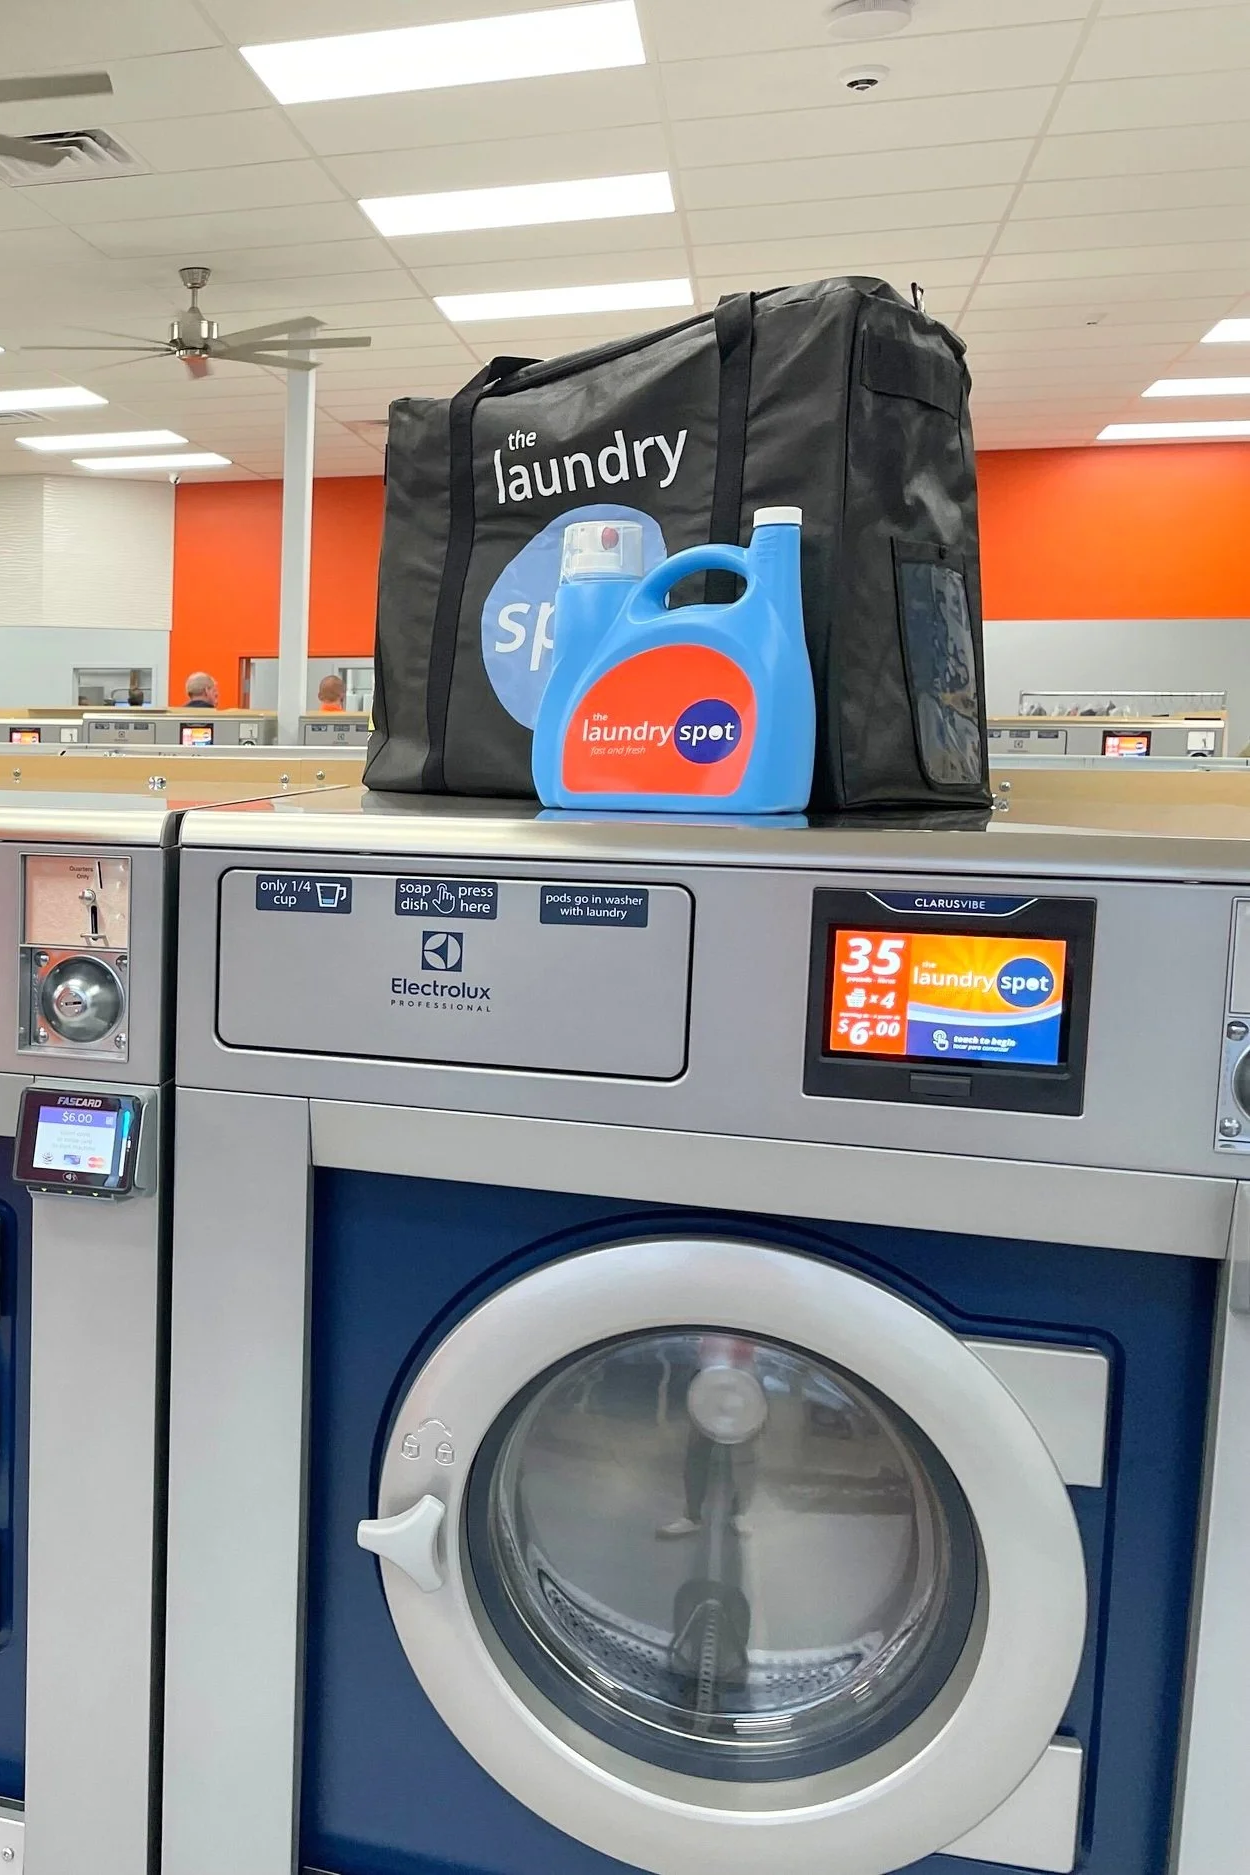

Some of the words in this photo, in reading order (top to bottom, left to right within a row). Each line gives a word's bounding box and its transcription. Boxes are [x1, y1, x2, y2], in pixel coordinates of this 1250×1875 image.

[508, 430, 537, 450] the
[494, 430, 687, 504] laundry
[495, 602, 556, 671] sp
[593, 713, 608, 721] the
[582, 719, 674, 747] laundry
[679, 722, 735, 747] spot
[590, 746, 607, 757] fast
[607, 746, 624, 755] and
[625, 746, 646, 757] fresh
[260, 880, 287, 894] only
[292, 881, 311, 893] 1/4
[400, 883, 431, 898] soap
[458, 886, 493, 899] press
[274, 894, 297, 907] cup
[401, 898, 428, 910] dish
[460, 901, 490, 914] here
[546, 893, 571, 905] pods
[574, 895, 589, 906] go
[592, 894, 602, 904] in
[605, 894, 642, 906] washer
[914, 898, 986, 910] CLARUSVIBE
[560, 906, 584, 918] with
[587, 907, 627, 920] laundry
[841, 937, 905, 976] 35
[922, 961, 937, 969] the
[913, 967, 997, 993] laundry
[1000, 974, 1049, 995] spot
[391, 978, 491, 1001] Electrolux
[391, 1000, 492, 1013] PROFESSIONAL
[880, 991, 896, 1009] 4
[837, 1019, 900, 1045] $6.00
[953, 1035, 979, 1044] touch
[57, 1096, 102, 1108] FASCARD
[62, 1111, 93, 1124] $6.00
